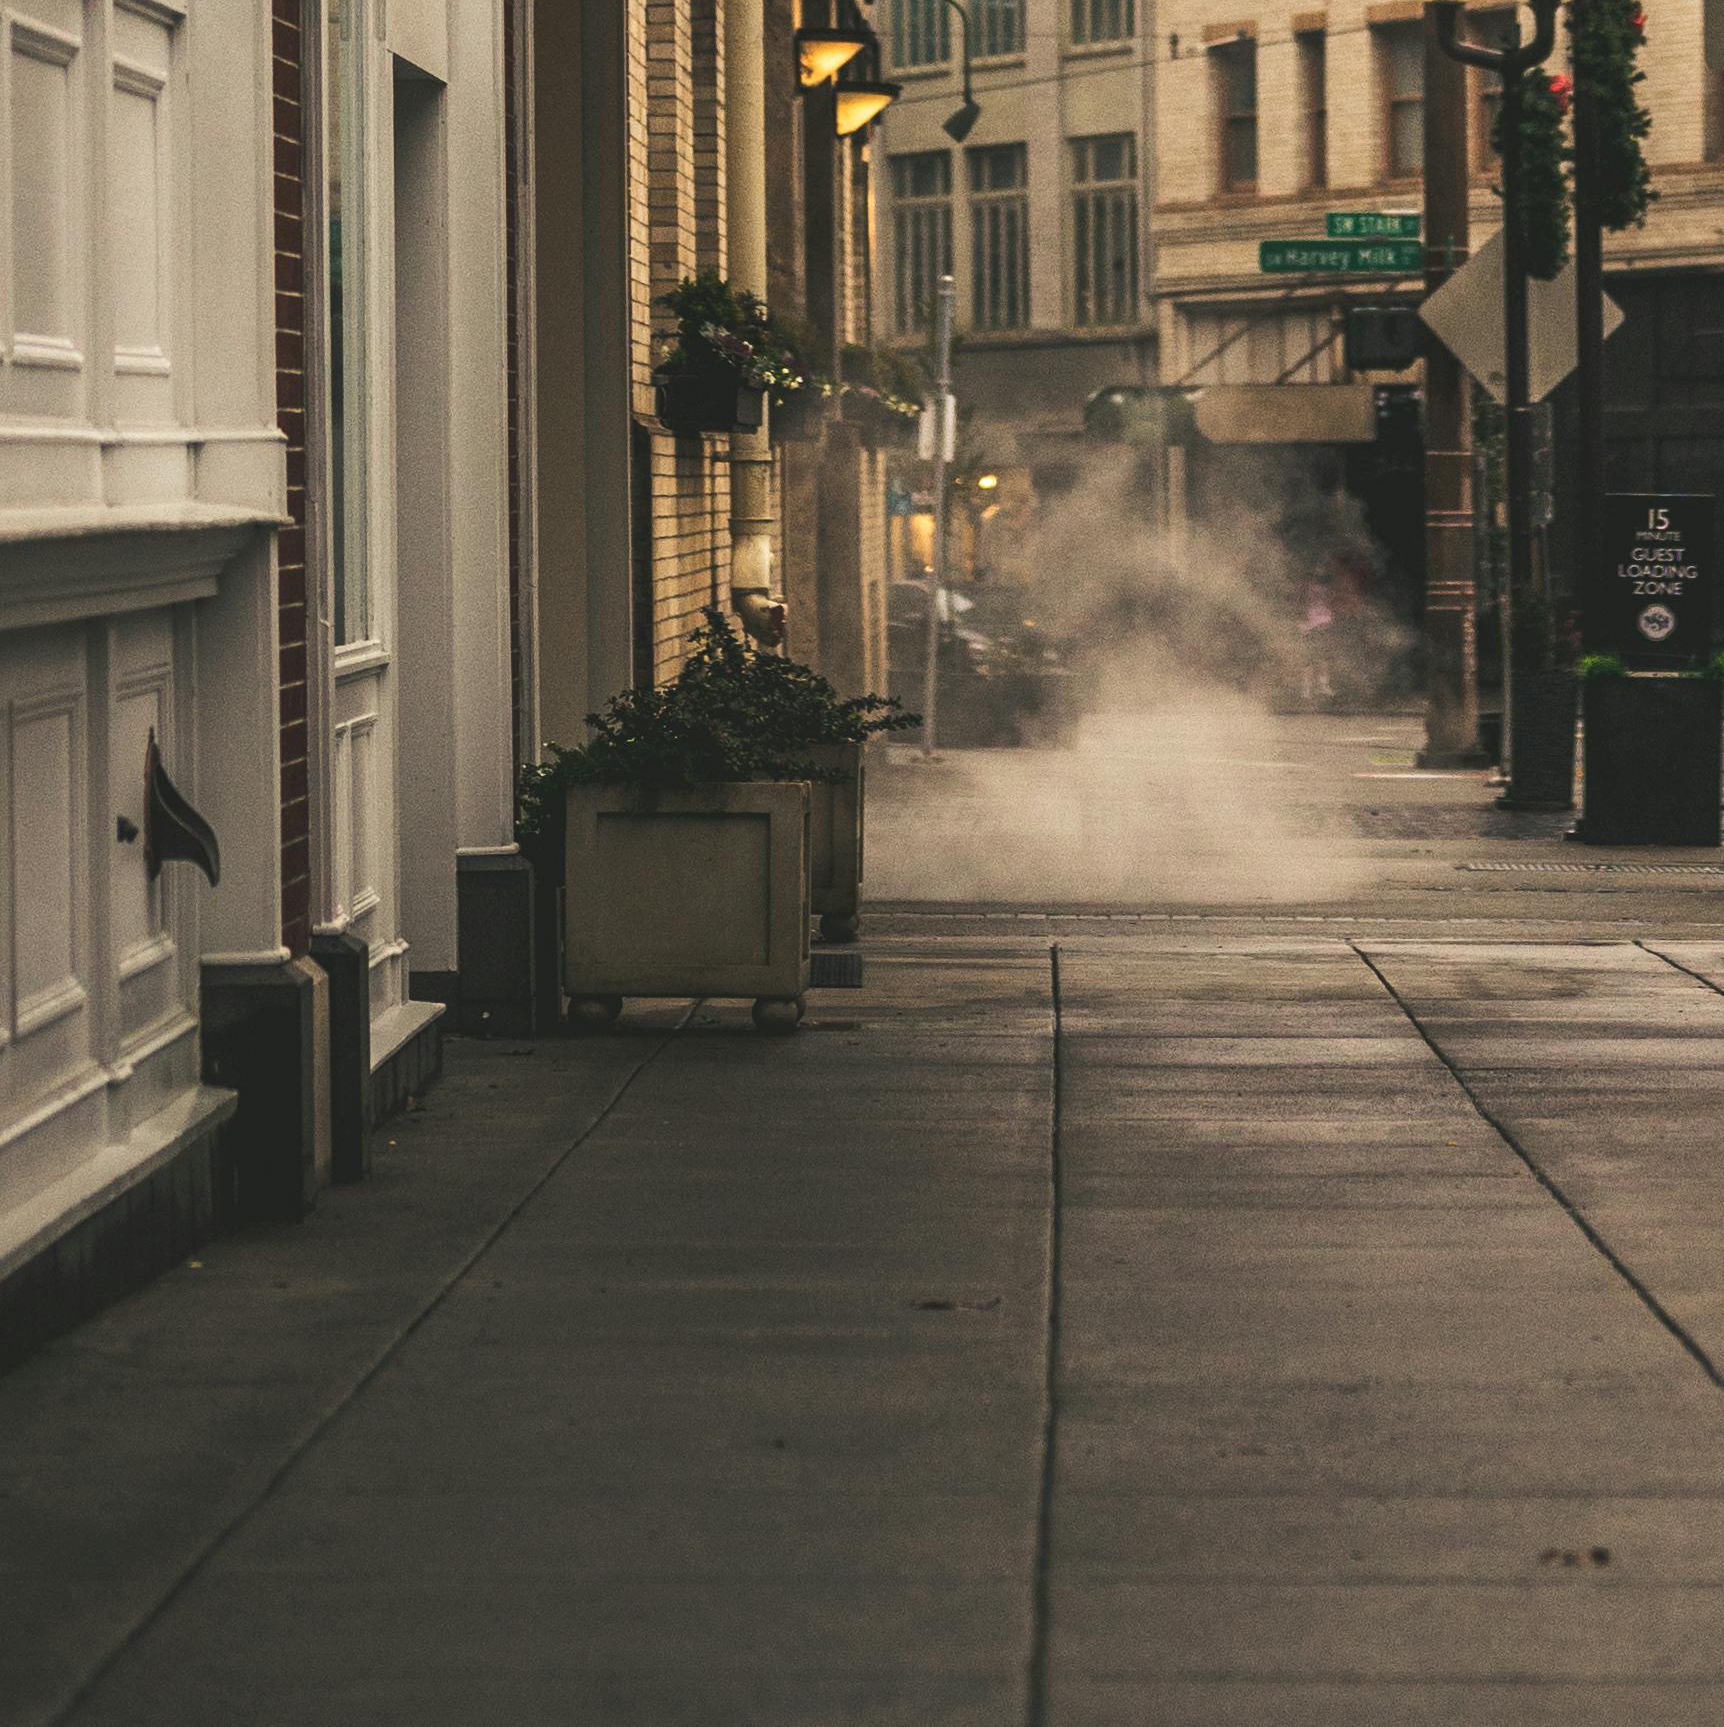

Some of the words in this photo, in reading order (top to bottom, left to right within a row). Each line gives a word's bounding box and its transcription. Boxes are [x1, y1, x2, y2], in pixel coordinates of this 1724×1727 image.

[1285, 249, 1349, 271] Harvey
[1358, 248, 1396, 265] Milk
[1647, 508, 1671, 530] 15
[1635, 531, 1682, 542] MINUTE
[1630, 548, 1686, 562] GUEST
[1617, 564, 1699, 579] LOADING
[1632, 581, 1684, 595] ZONE
